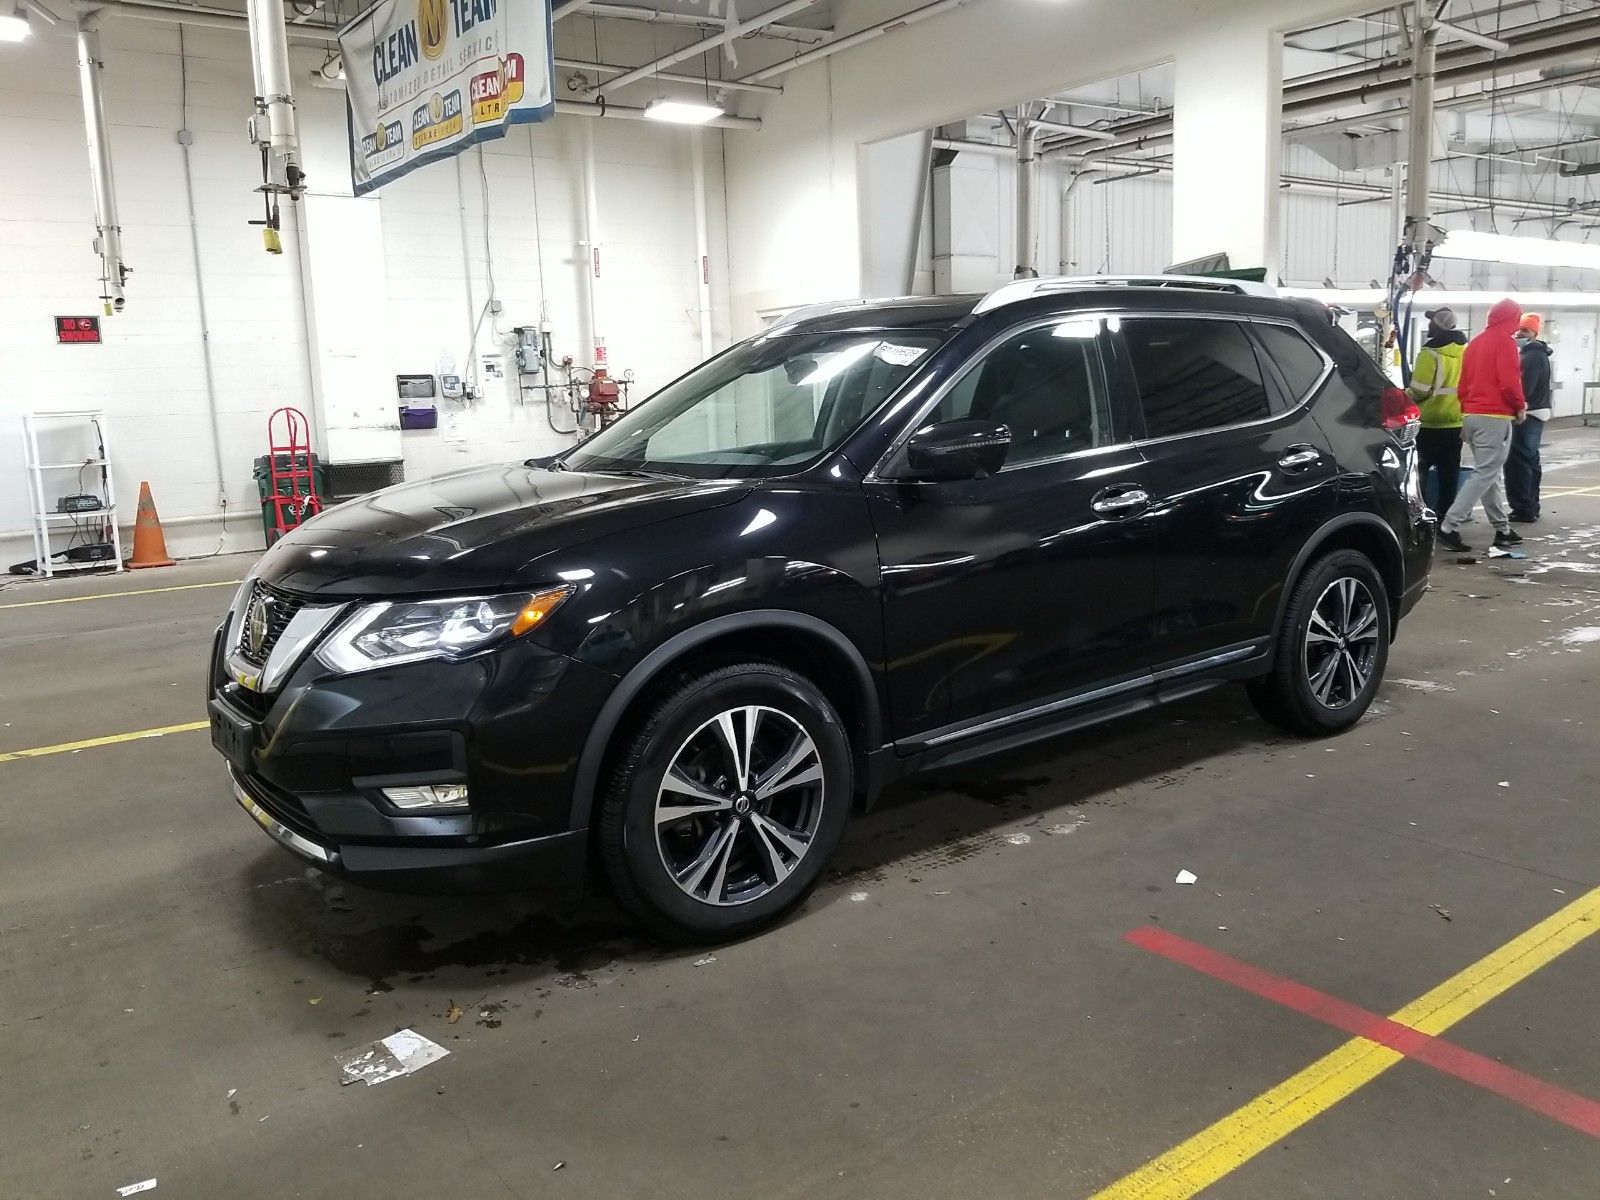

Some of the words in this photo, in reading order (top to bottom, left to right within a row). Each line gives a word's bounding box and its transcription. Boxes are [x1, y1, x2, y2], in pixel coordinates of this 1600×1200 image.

[373, 19, 419, 86] CLEAN
[63, 319, 75, 330] NO
[60, 330, 98, 341] SMOKING
